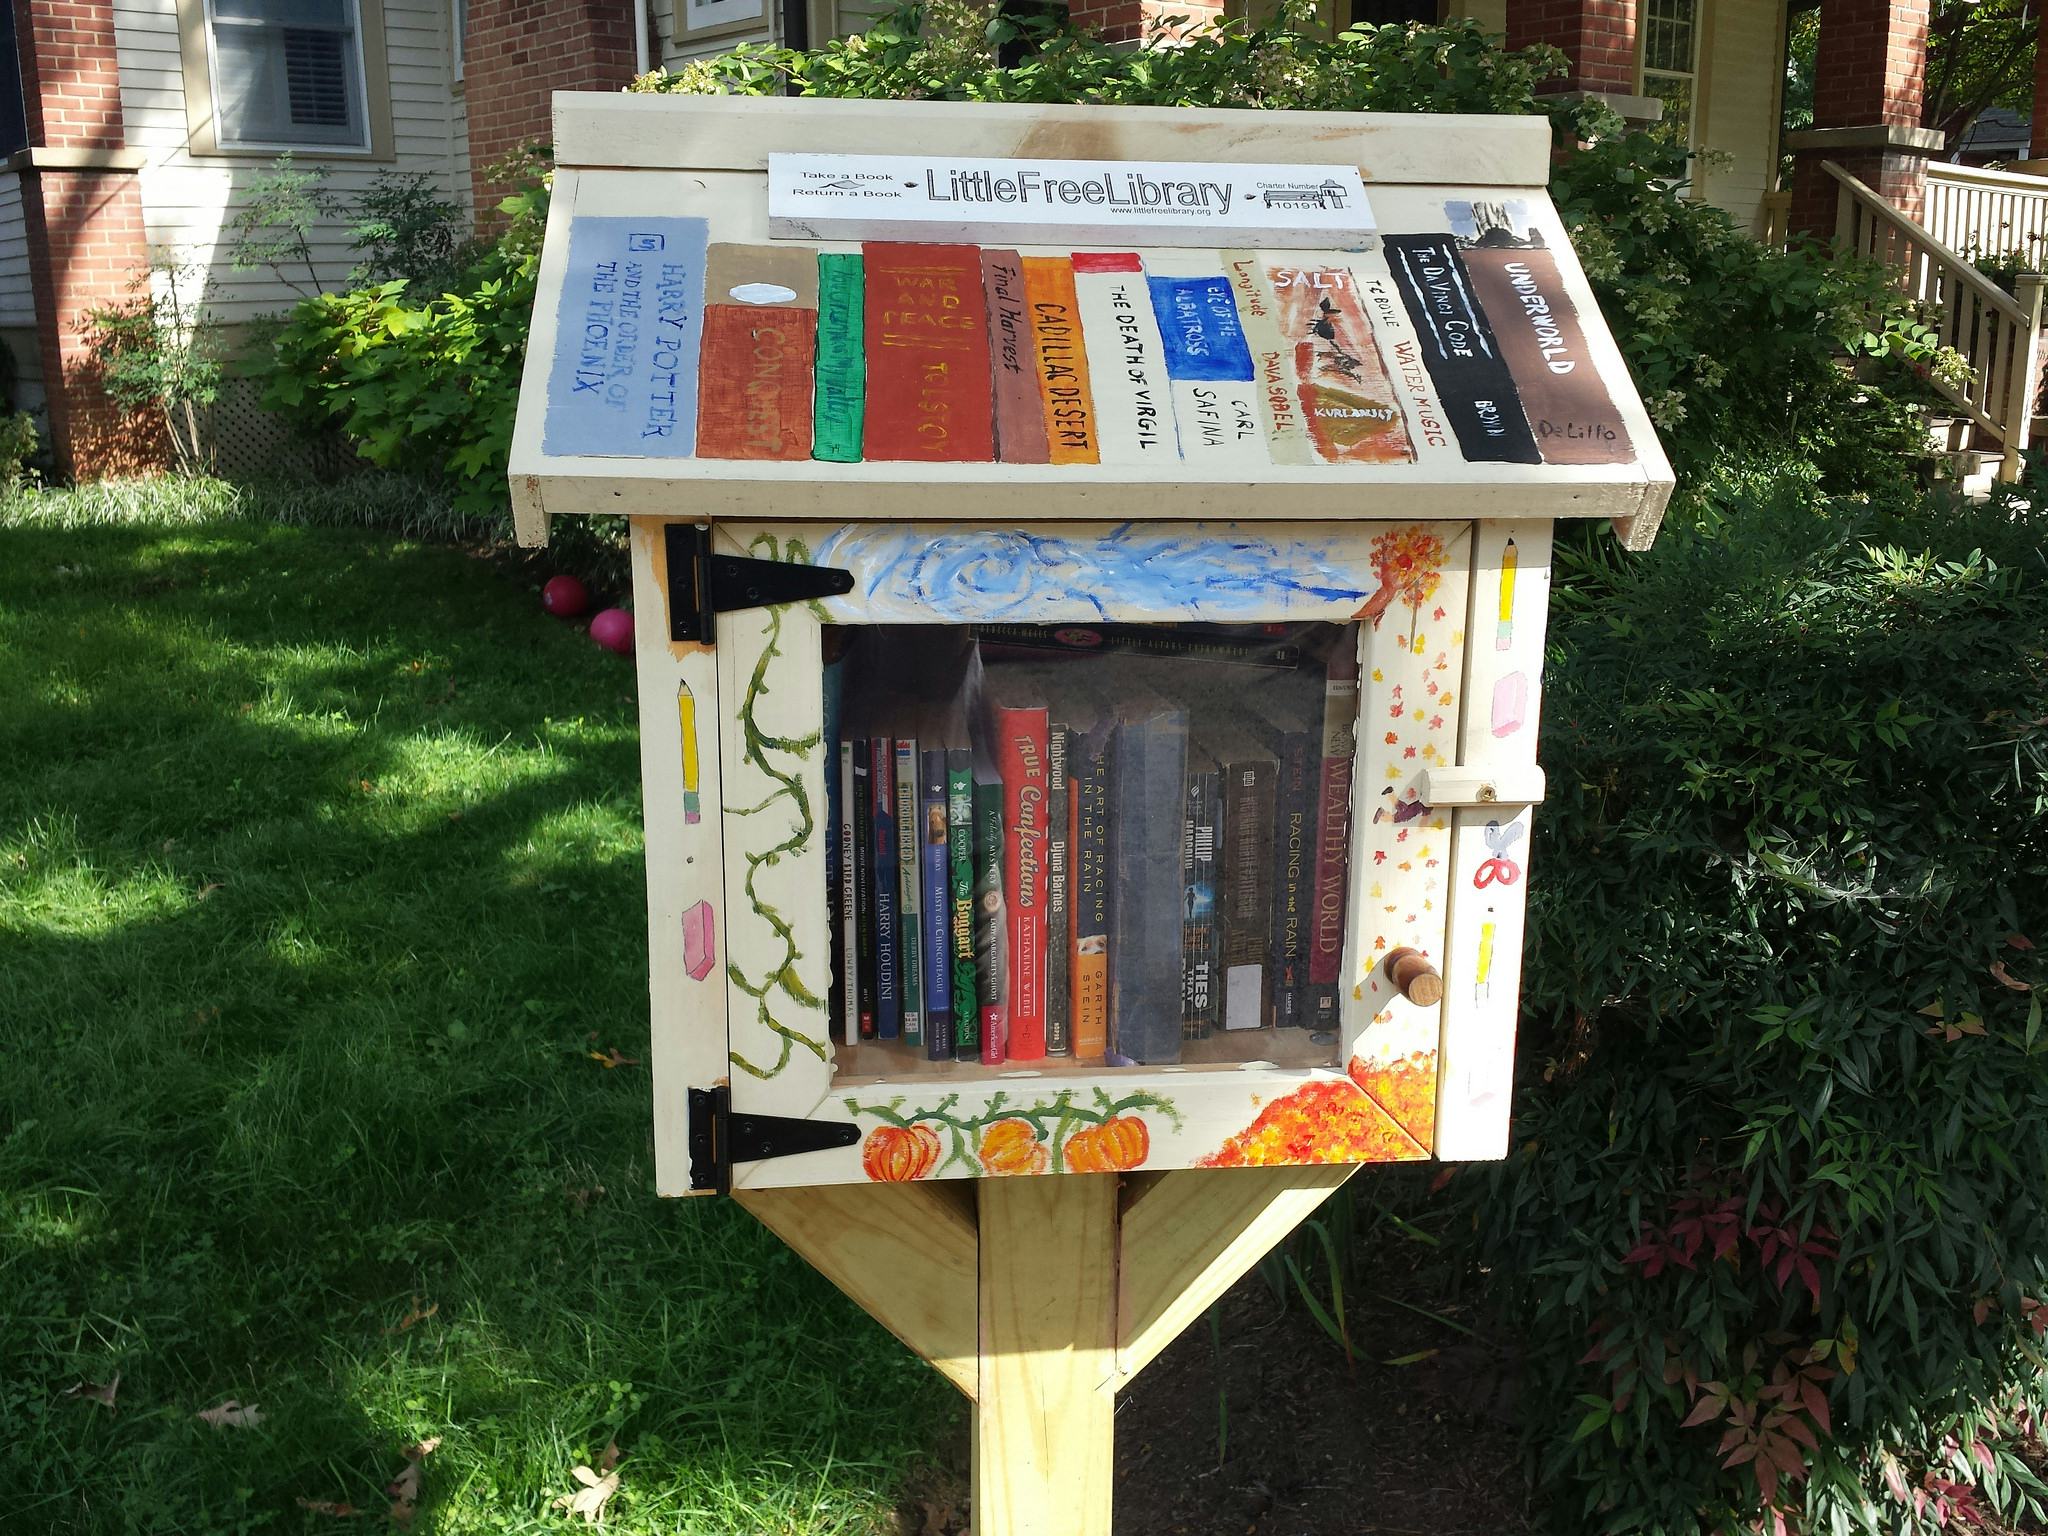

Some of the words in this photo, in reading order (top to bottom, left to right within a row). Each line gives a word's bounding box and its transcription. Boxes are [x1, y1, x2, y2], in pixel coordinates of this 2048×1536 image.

[793, 188, 844, 197] Return
[863, 190, 902, 198] Book
[800, 171, 836, 180] Take
[855, 173, 893, 181] Book
[926, 169, 1232, 214] LittleFreeLibrary
[1256, 181, 1285, 190] Charter
[1288, 182, 1319, 190] Number
[1110, 206, 1211, 217] www.littlefreelibrary.org
[1275, 201, 1318, 209] 10191
[593, 261, 618, 293] THE
[625, 261, 642, 289] AND
[895, 276, 958, 291] WAR
[992, 263, 1021, 309] Final
[1232, 260, 1271, 317] Longitude
[1273, 270, 1349, 290] SALT
[620, 291, 642, 319] THE
[656, 263, 687, 330] HARRY
[897, 293, 960, 310] AND
[1109, 285, 1132, 308] THE
[1210, 306, 1232, 322] OF
[1374, 296, 1400, 328] BOYLE
[881, 310, 977, 330] PEACE
[1174, 288, 1210, 357] ALBATROSS
[1217, 320, 1238, 337] THE
[1504, 262, 1576, 375] UNDERWORLD
[572, 300, 614, 395] PHOENIX
[606, 322, 638, 381] ORDER
[999, 307, 1024, 375] Harvest
[1034, 303, 1078, 382] CADILLAC
[1115, 314, 1145, 364] DEATH
[1128, 369, 1149, 386] OF
[1261, 351, 1285, 384] DAVA
[605, 383, 629, 412] OF
[641, 336, 681, 440] POTTER
[1393, 340, 1423, 393] WATER
[1413, 397, 1448, 448] MUSIC
[917, 362, 949, 453] TOLSTOY
[1048, 387, 1089, 450] DESERT
[1135, 390, 1158, 450] VIRGIL
[1193, 387, 1225, 448] SAFINA
[1231, 400, 1255, 441] CARL
[1266, 386, 1296, 431] SOBEL
[1474, 400, 1505, 437] BROWN
[1014, 735, 1041, 778] TRUE
[1050, 732, 1066, 792] Nightwood
[1329, 731, 1340, 757] NEW
[1084, 777, 1093, 795] IN
[1095, 785, 1105, 816] ART
[900, 785, 913, 862] THOROUGHBRED
[1083, 805, 1093, 839] THE
[1324, 760, 1348, 864] WEALTHY
[844, 823, 852, 861] GOONEY
[958, 828, 967, 862] COOPER
[1012, 785, 1043, 908] Confections
[1095, 825, 1105, 846] OF
[1195, 826, 1213, 861] PHILLIP
[1288, 812, 1302, 878] RACING
[844, 863, 852, 884] BIRD
[988, 844, 998, 884] MYSTERY
[1050, 841, 1065, 872] Djuna
[1083, 850, 1093, 892] RAIN
[844, 887, 853, 921] GREENE
[936, 886, 944, 912] MISTY
[1052, 875, 1065, 913] Barnes
[1095, 854, 1105, 922] RACING
[1287, 883, 1297, 893] in
[1287, 894, 1296, 913] the
[879, 893, 891, 939] HARRY
[936, 915, 943, 926] OF
[952, 898, 975, 959] Boggart
[1319, 875, 1343, 954] WORLD
[1022, 916, 1031, 976] KATHARINE
[1285, 917, 1298, 958] RAIN
[880, 944, 892, 1001] HOUDINI
[935, 928, 945, 993] CHINCOTEAGUE
[990, 979, 998, 1001] GHOST
[1022, 983, 1031, 1017] WEBER
[1082, 974, 1091, 1024] STEIN
[1095, 970, 1103, 1026] GARTH
[1187, 969, 1195, 1002] THAT
[1194, 961, 1210, 1009] TIES
